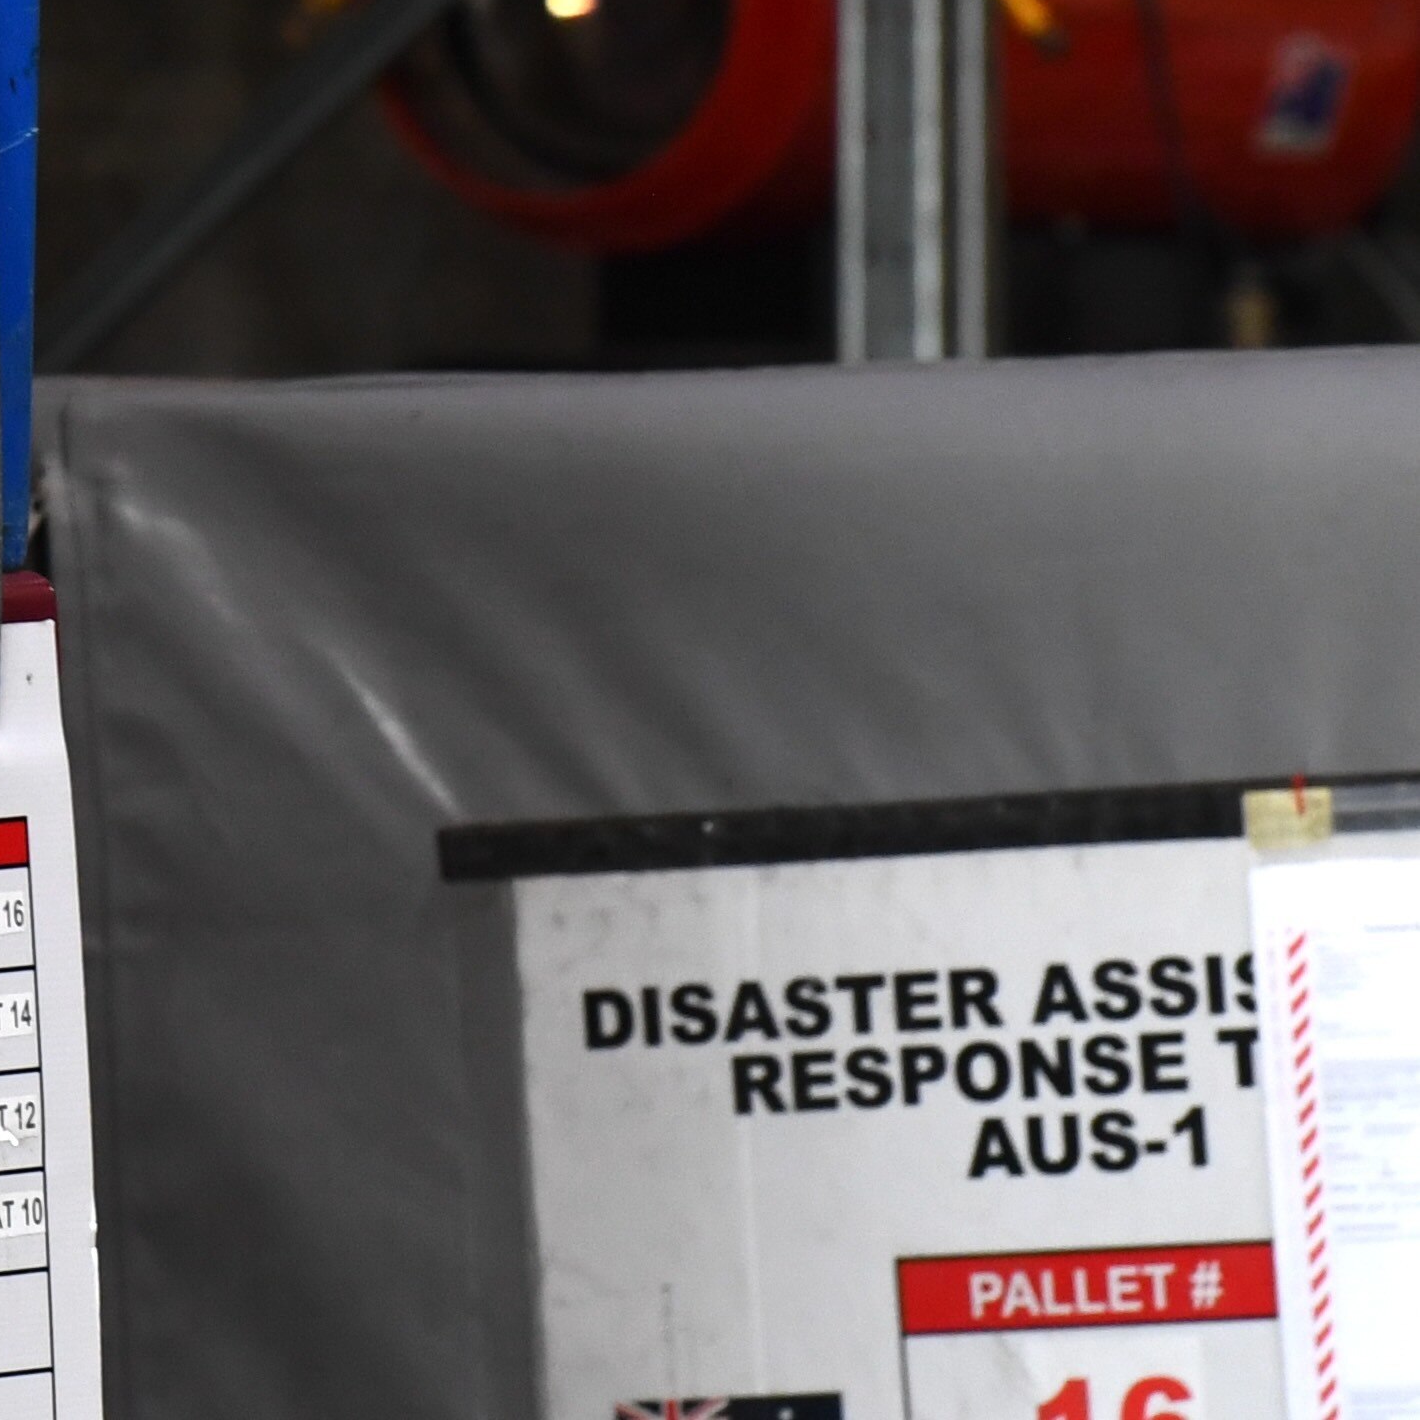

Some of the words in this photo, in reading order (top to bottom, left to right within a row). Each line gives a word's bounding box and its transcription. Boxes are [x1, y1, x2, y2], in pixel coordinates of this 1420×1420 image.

[3, 899, 25, 929] 16
[11, 1000, 32, 1029] 14
[581, 969, 1003, 1051] DISASTER
[731, 1032, 1188, 1115] RESPONSE
[14, 1101, 36, 1131] 12
[968, 1105, 1210, 1178] AUS-1
[22, 1197, 44, 1228] 10
[969, 1262, 1175, 1319] PALLET
[1189, 1260, 1224, 1309] #
